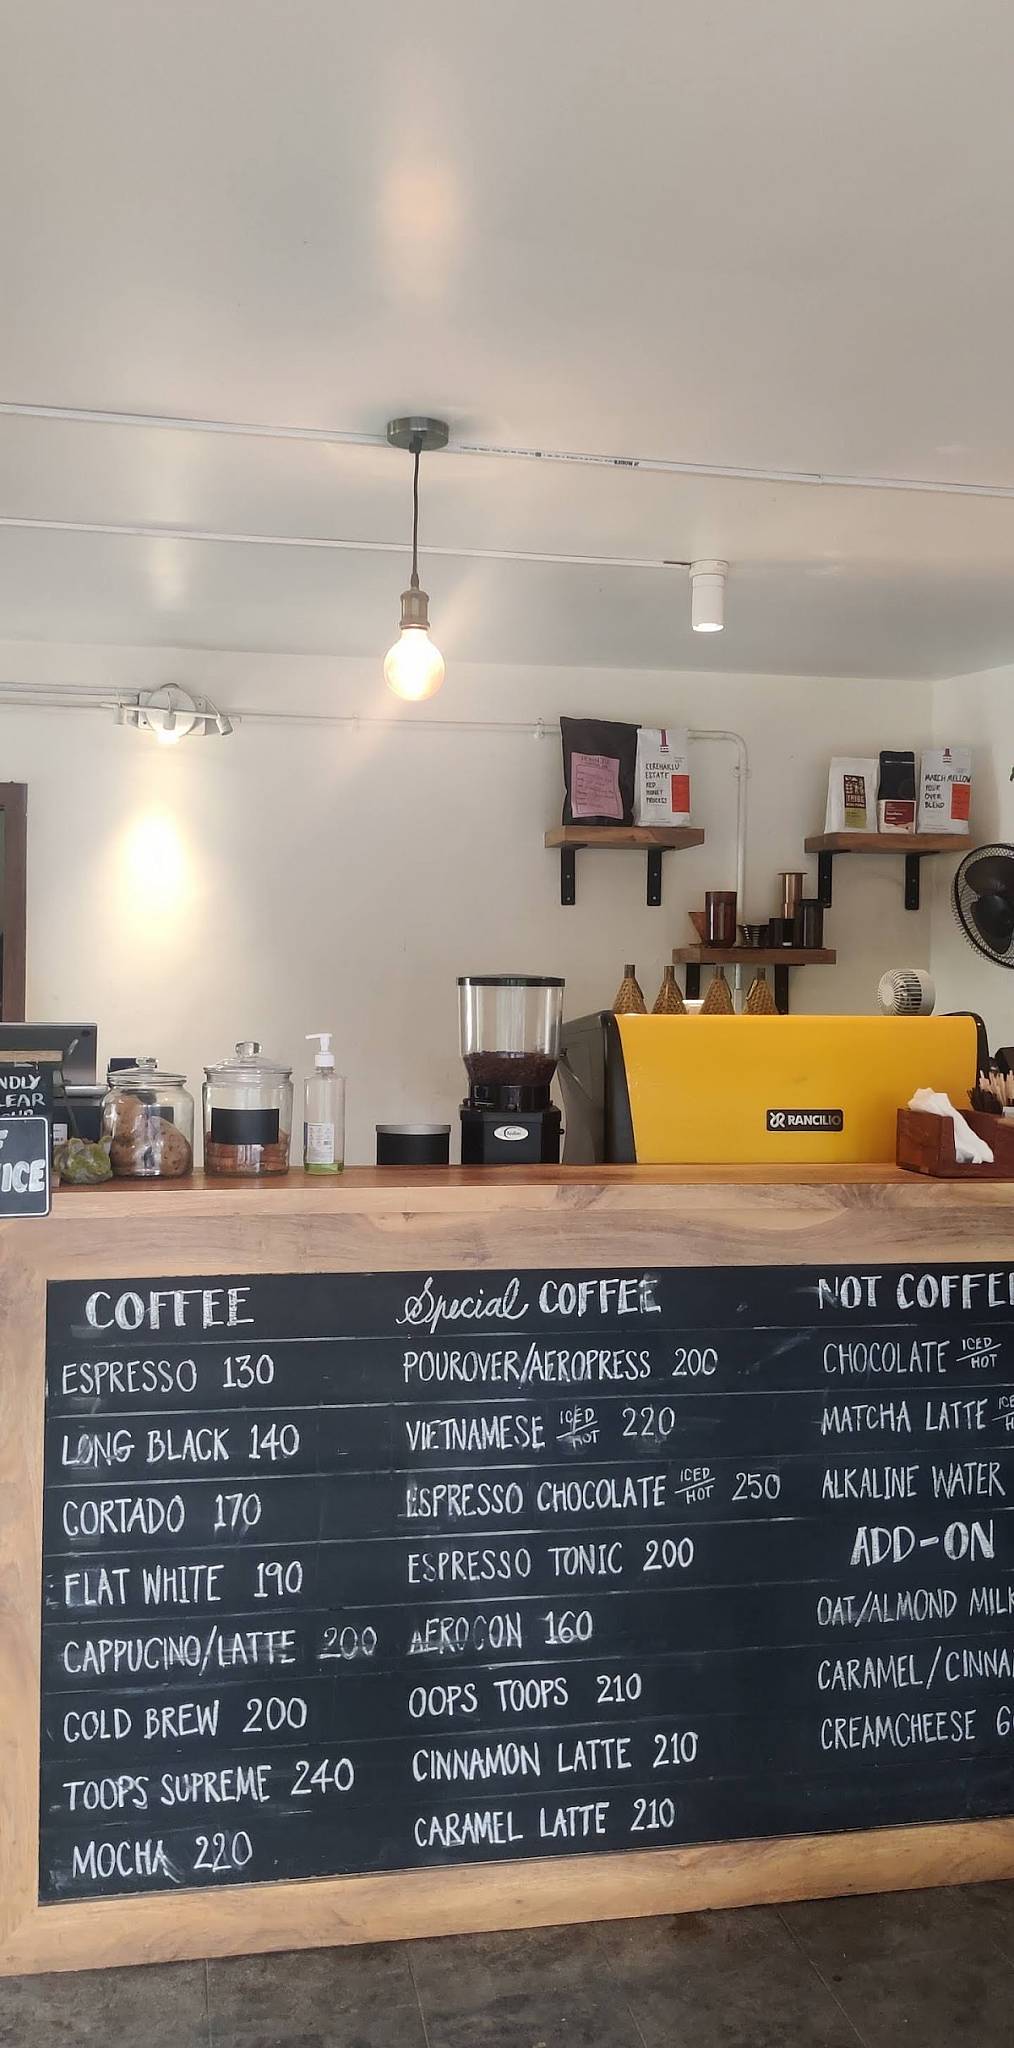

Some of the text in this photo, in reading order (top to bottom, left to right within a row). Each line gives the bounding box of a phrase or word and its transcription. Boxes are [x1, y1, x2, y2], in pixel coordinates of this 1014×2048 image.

[645, 772, 669, 780] ESTATE
[0, 1092, 46, 1108] EAR
[787, 1115, 842, 1126] RANCILIO
[0, 1159, 46, 1192] ICE
[85, 1287, 254, 1330] COFFEE
[396, 1277, 661, 1333] Special COFFEE
[818, 1275, 882, 1309] NOT
[61, 1354, 274, 1395] ESPRESSO 130
[403, 1342, 718, 1382] POUROVER/AEROPRESS 200
[823, 1337, 997, 1375] CHOCOLATE ICED HOT
[405, 1405, 676, 1450] VIETNAMESE ICED HOT 220
[821, 1401, 912, 1436] MATCHA
[925, 1398, 988, 1431] LATTE
[61, 1424, 300, 1468] LONG BLACK 140
[405, 1467, 781, 1519] ESPRESSO CHOCOLATE ICED HOT 250
[822, 1461, 1006, 1500] ALKALINE WATER
[62, 1492, 262, 1537] CORTADO 170
[408, 1537, 695, 1583] ESPRESSO TONIC 200
[849, 1519, 995, 1567] ADD-ON
[64, 1560, 304, 1607] FLAT WHITE 190
[541, 1610, 594, 1644] 160
[817, 1588, 958, 1628] OAT/ALMOND
[62, 1624, 378, 1676] CAPPUCINO/LATTE 200
[408, 1673, 642, 1718] OOPS TOOPS 210
[63, 1697, 308, 1743] COLD BREW 200
[820, 1705, 1014, 1750] CREAMCHEESE 6
[412, 1731, 699, 1782] CINNAMON LATTE 210
[62, 1757, 354, 1811] TOOPS SUPREME 240
[414, 1798, 676, 1847] CARAMEL LATTE 210
[72, 1831, 253, 1883] MOCHA 220
